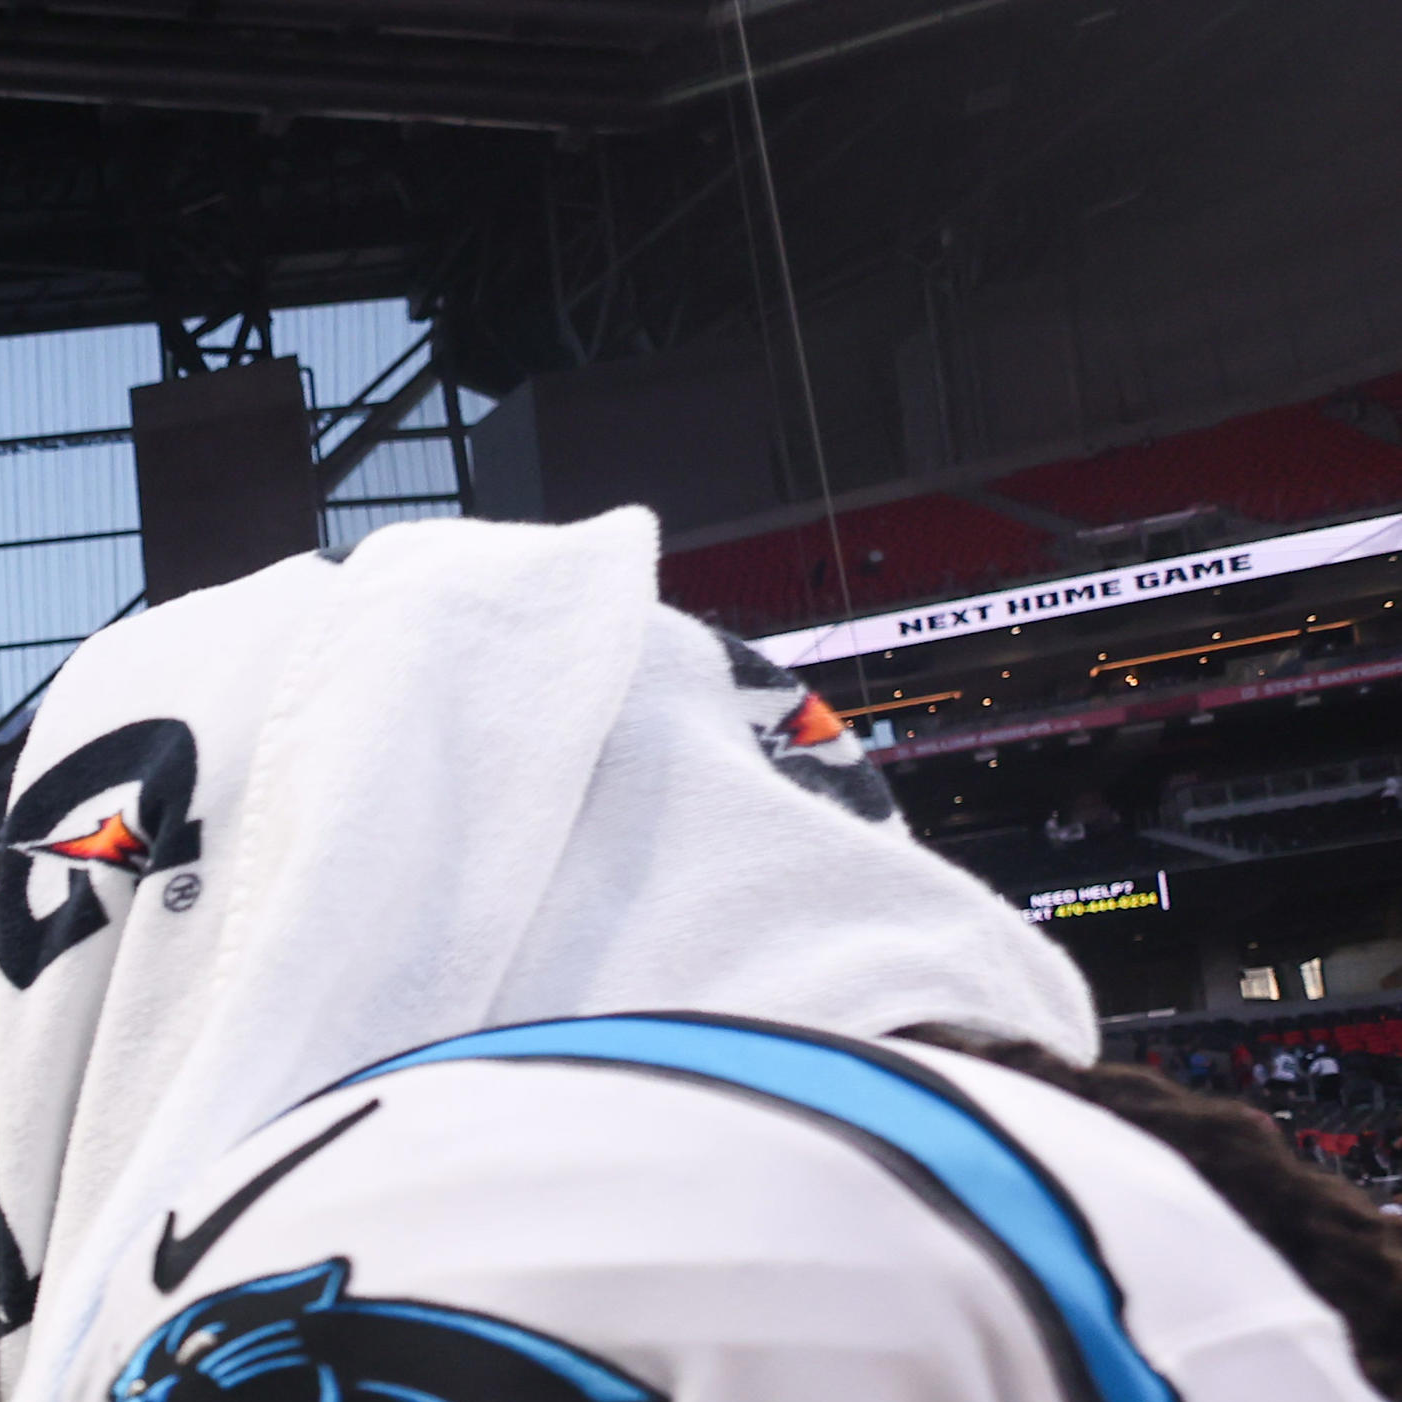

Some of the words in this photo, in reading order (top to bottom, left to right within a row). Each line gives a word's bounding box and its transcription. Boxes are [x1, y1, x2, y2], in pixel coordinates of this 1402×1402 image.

[898, 604, 993, 636] NEXT
[1008, 580, 1122, 615] HOME
[1135, 553, 1252, 590] GAME
